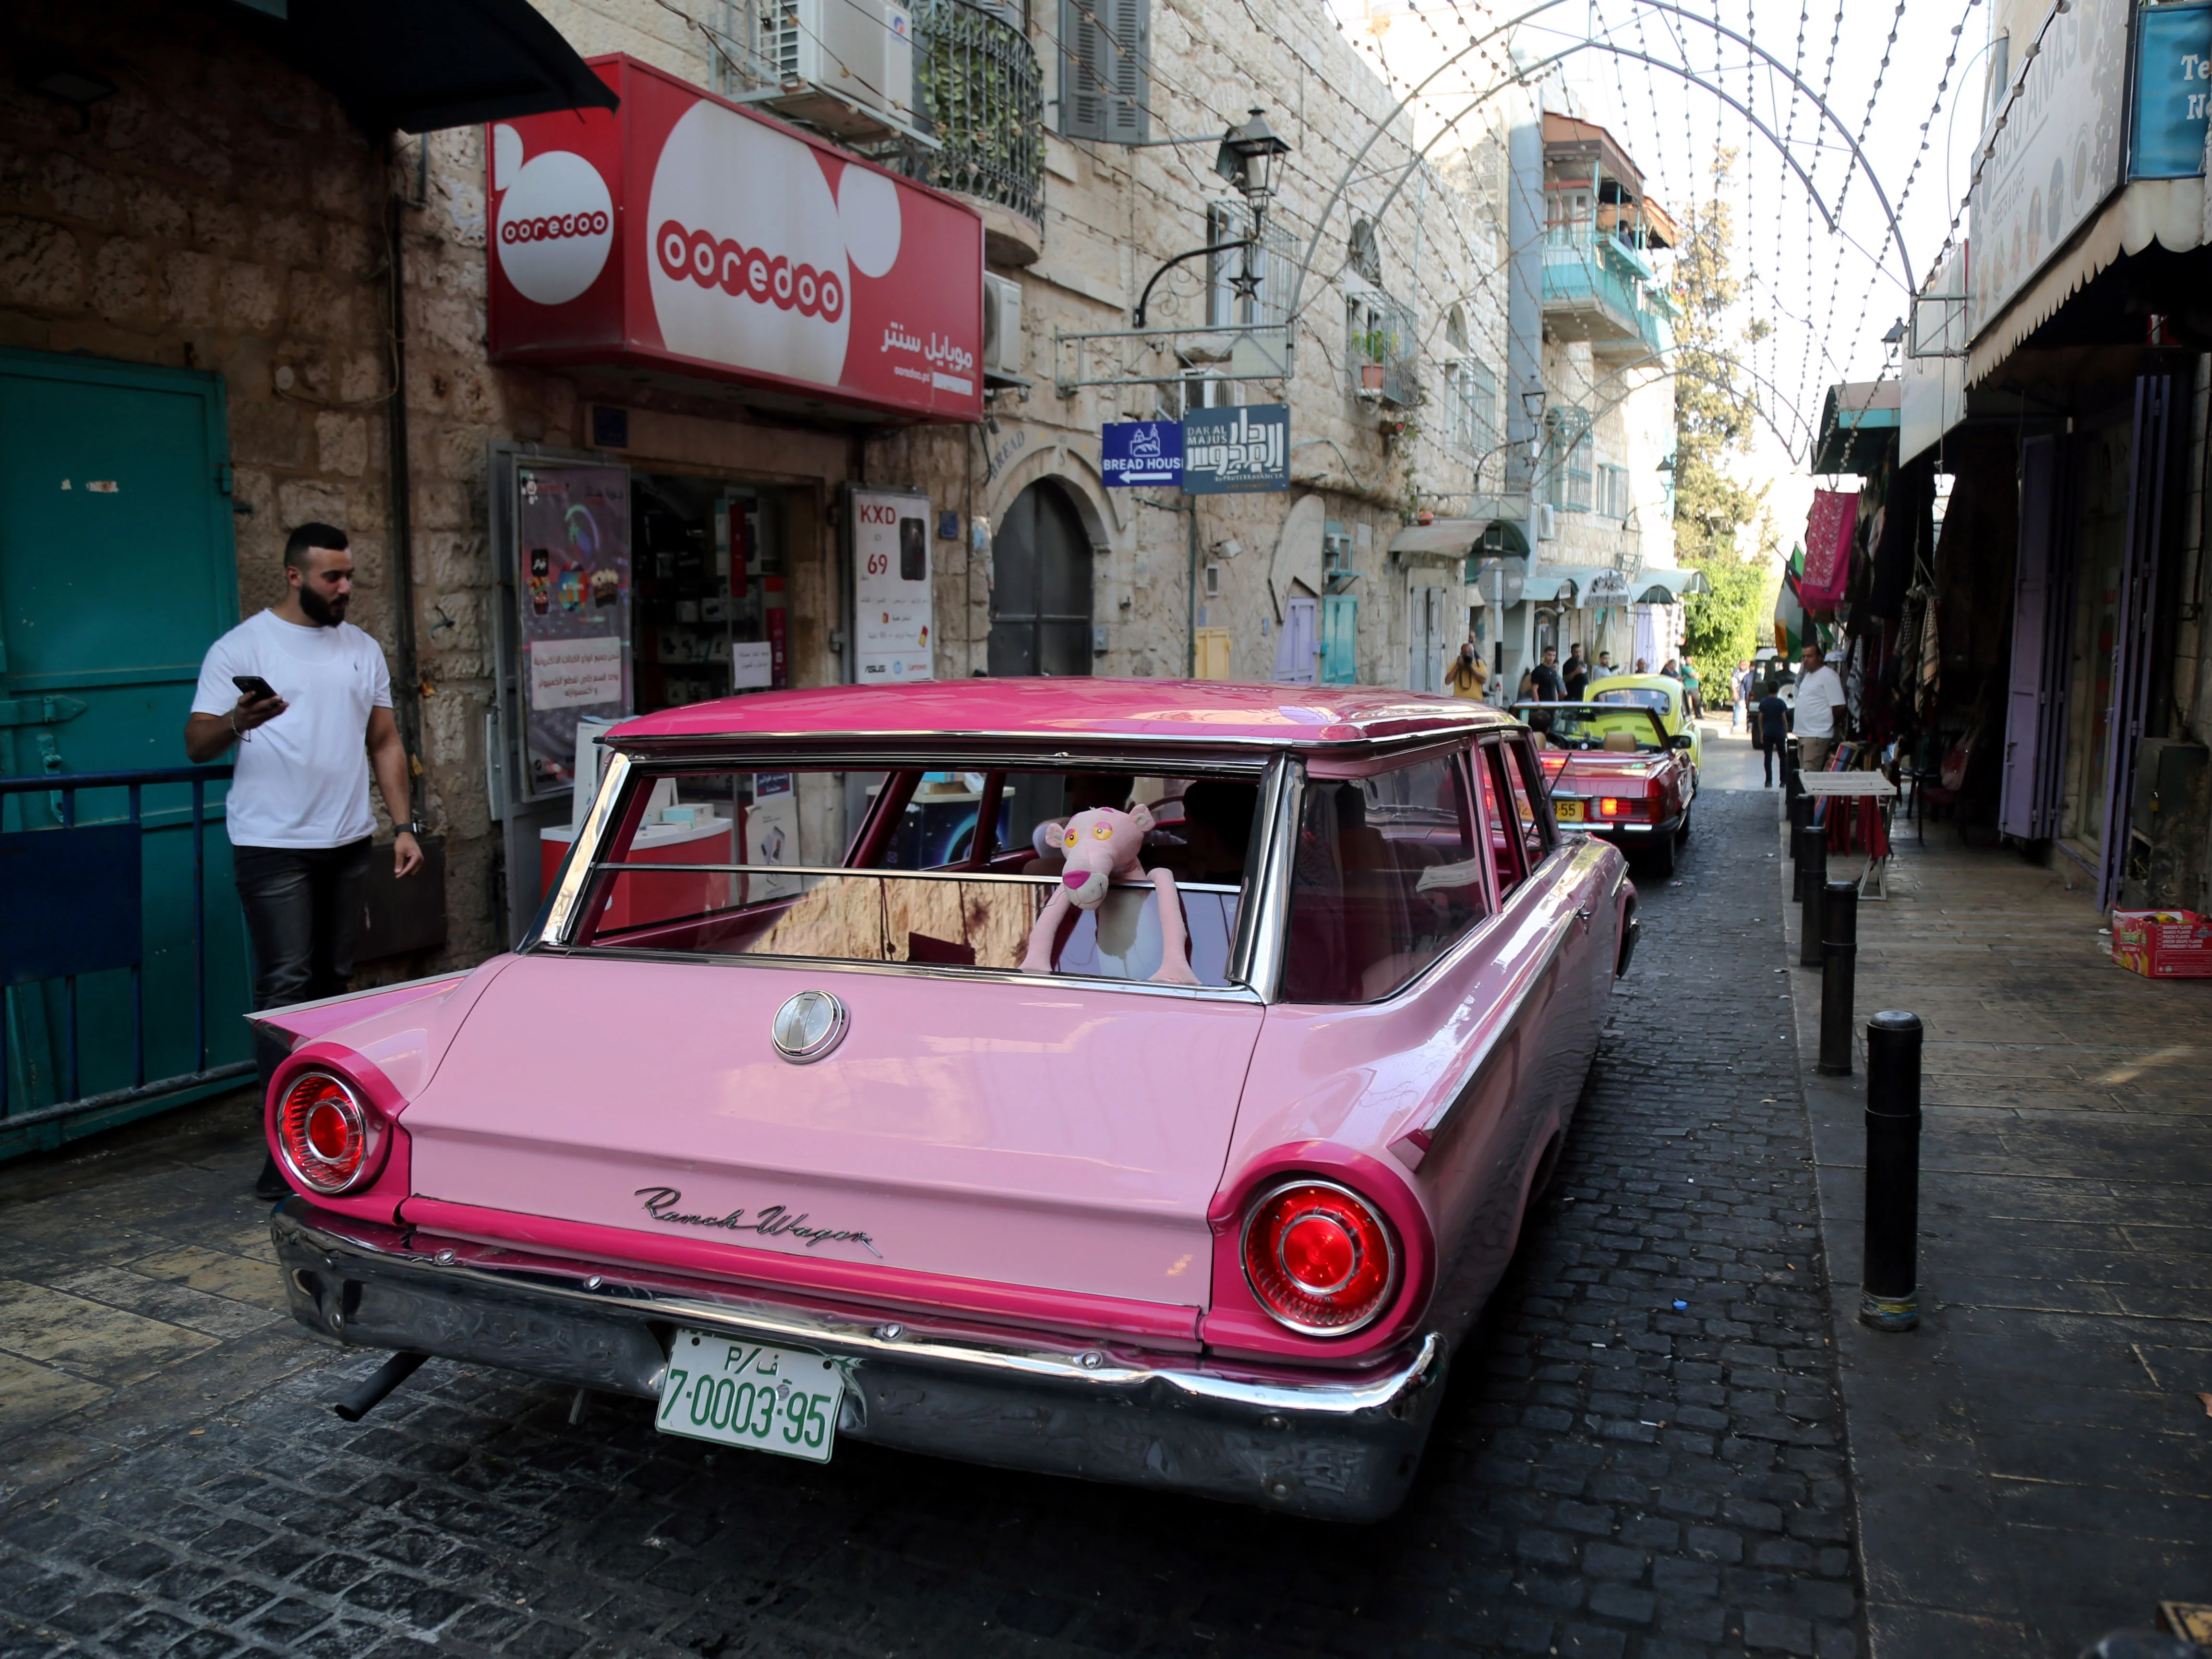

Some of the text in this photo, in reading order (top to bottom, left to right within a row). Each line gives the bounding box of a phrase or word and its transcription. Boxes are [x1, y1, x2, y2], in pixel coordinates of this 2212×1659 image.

[503, 212, 608, 244] ooredoo
[658, 221, 843, 322] ooredoo
[880, 321, 973, 371] موبايل سنتر
[1187, 425, 1226, 436] DAR AL
[1187, 435, 1228, 445] MAJUS
[1104, 458, 1143, 470] BREAD
[860, 505, 896, 525] KXD
[867, 553, 888, 575] 69
[865, 665, 886, 673] ASUS
[635, 1187, 883, 1258] Ranch Wagon
